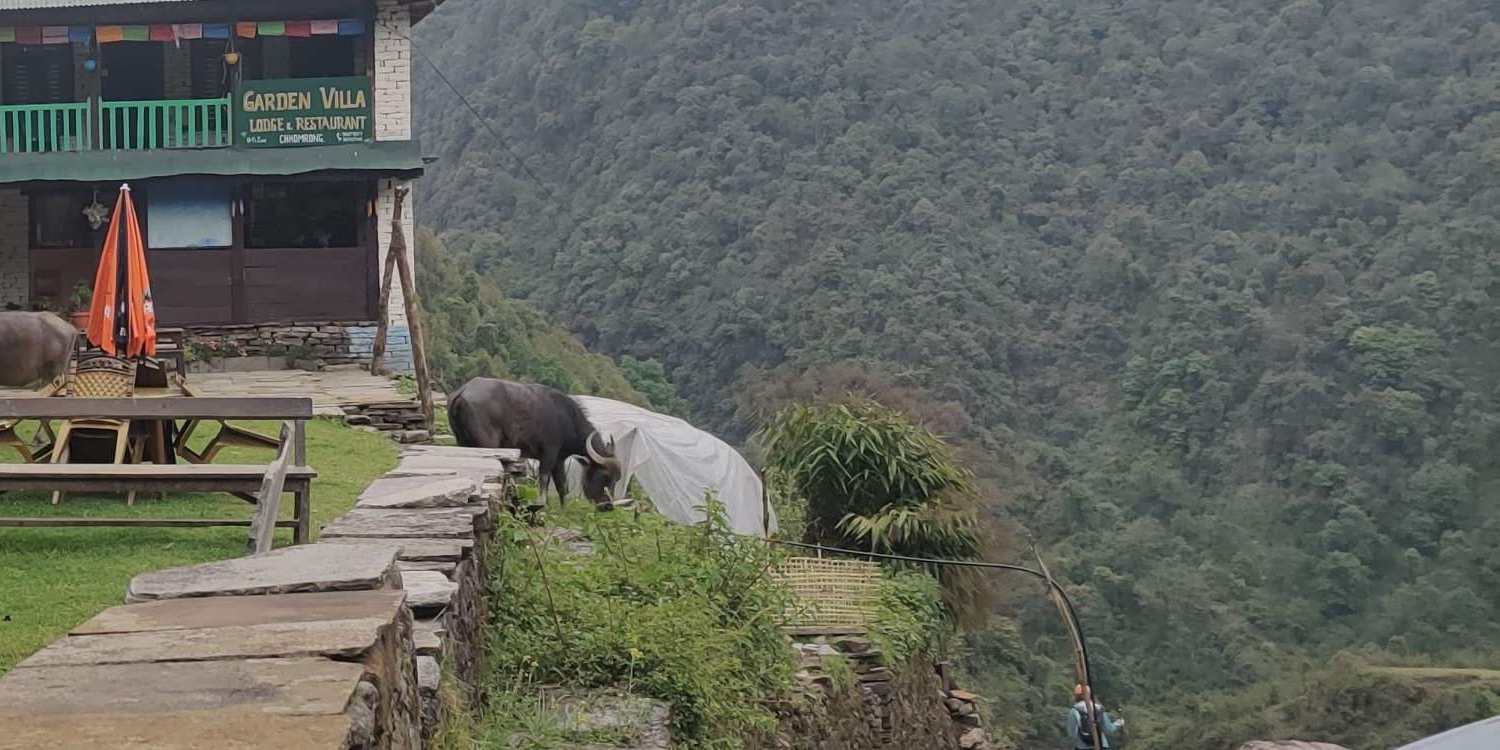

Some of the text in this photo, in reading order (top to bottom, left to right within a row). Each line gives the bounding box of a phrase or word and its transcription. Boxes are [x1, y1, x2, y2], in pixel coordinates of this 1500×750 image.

[243, 91, 311, 112] GARDEN
[249, 118, 284, 133] LODGE
[295, 116, 367, 131] RESTAURANT
